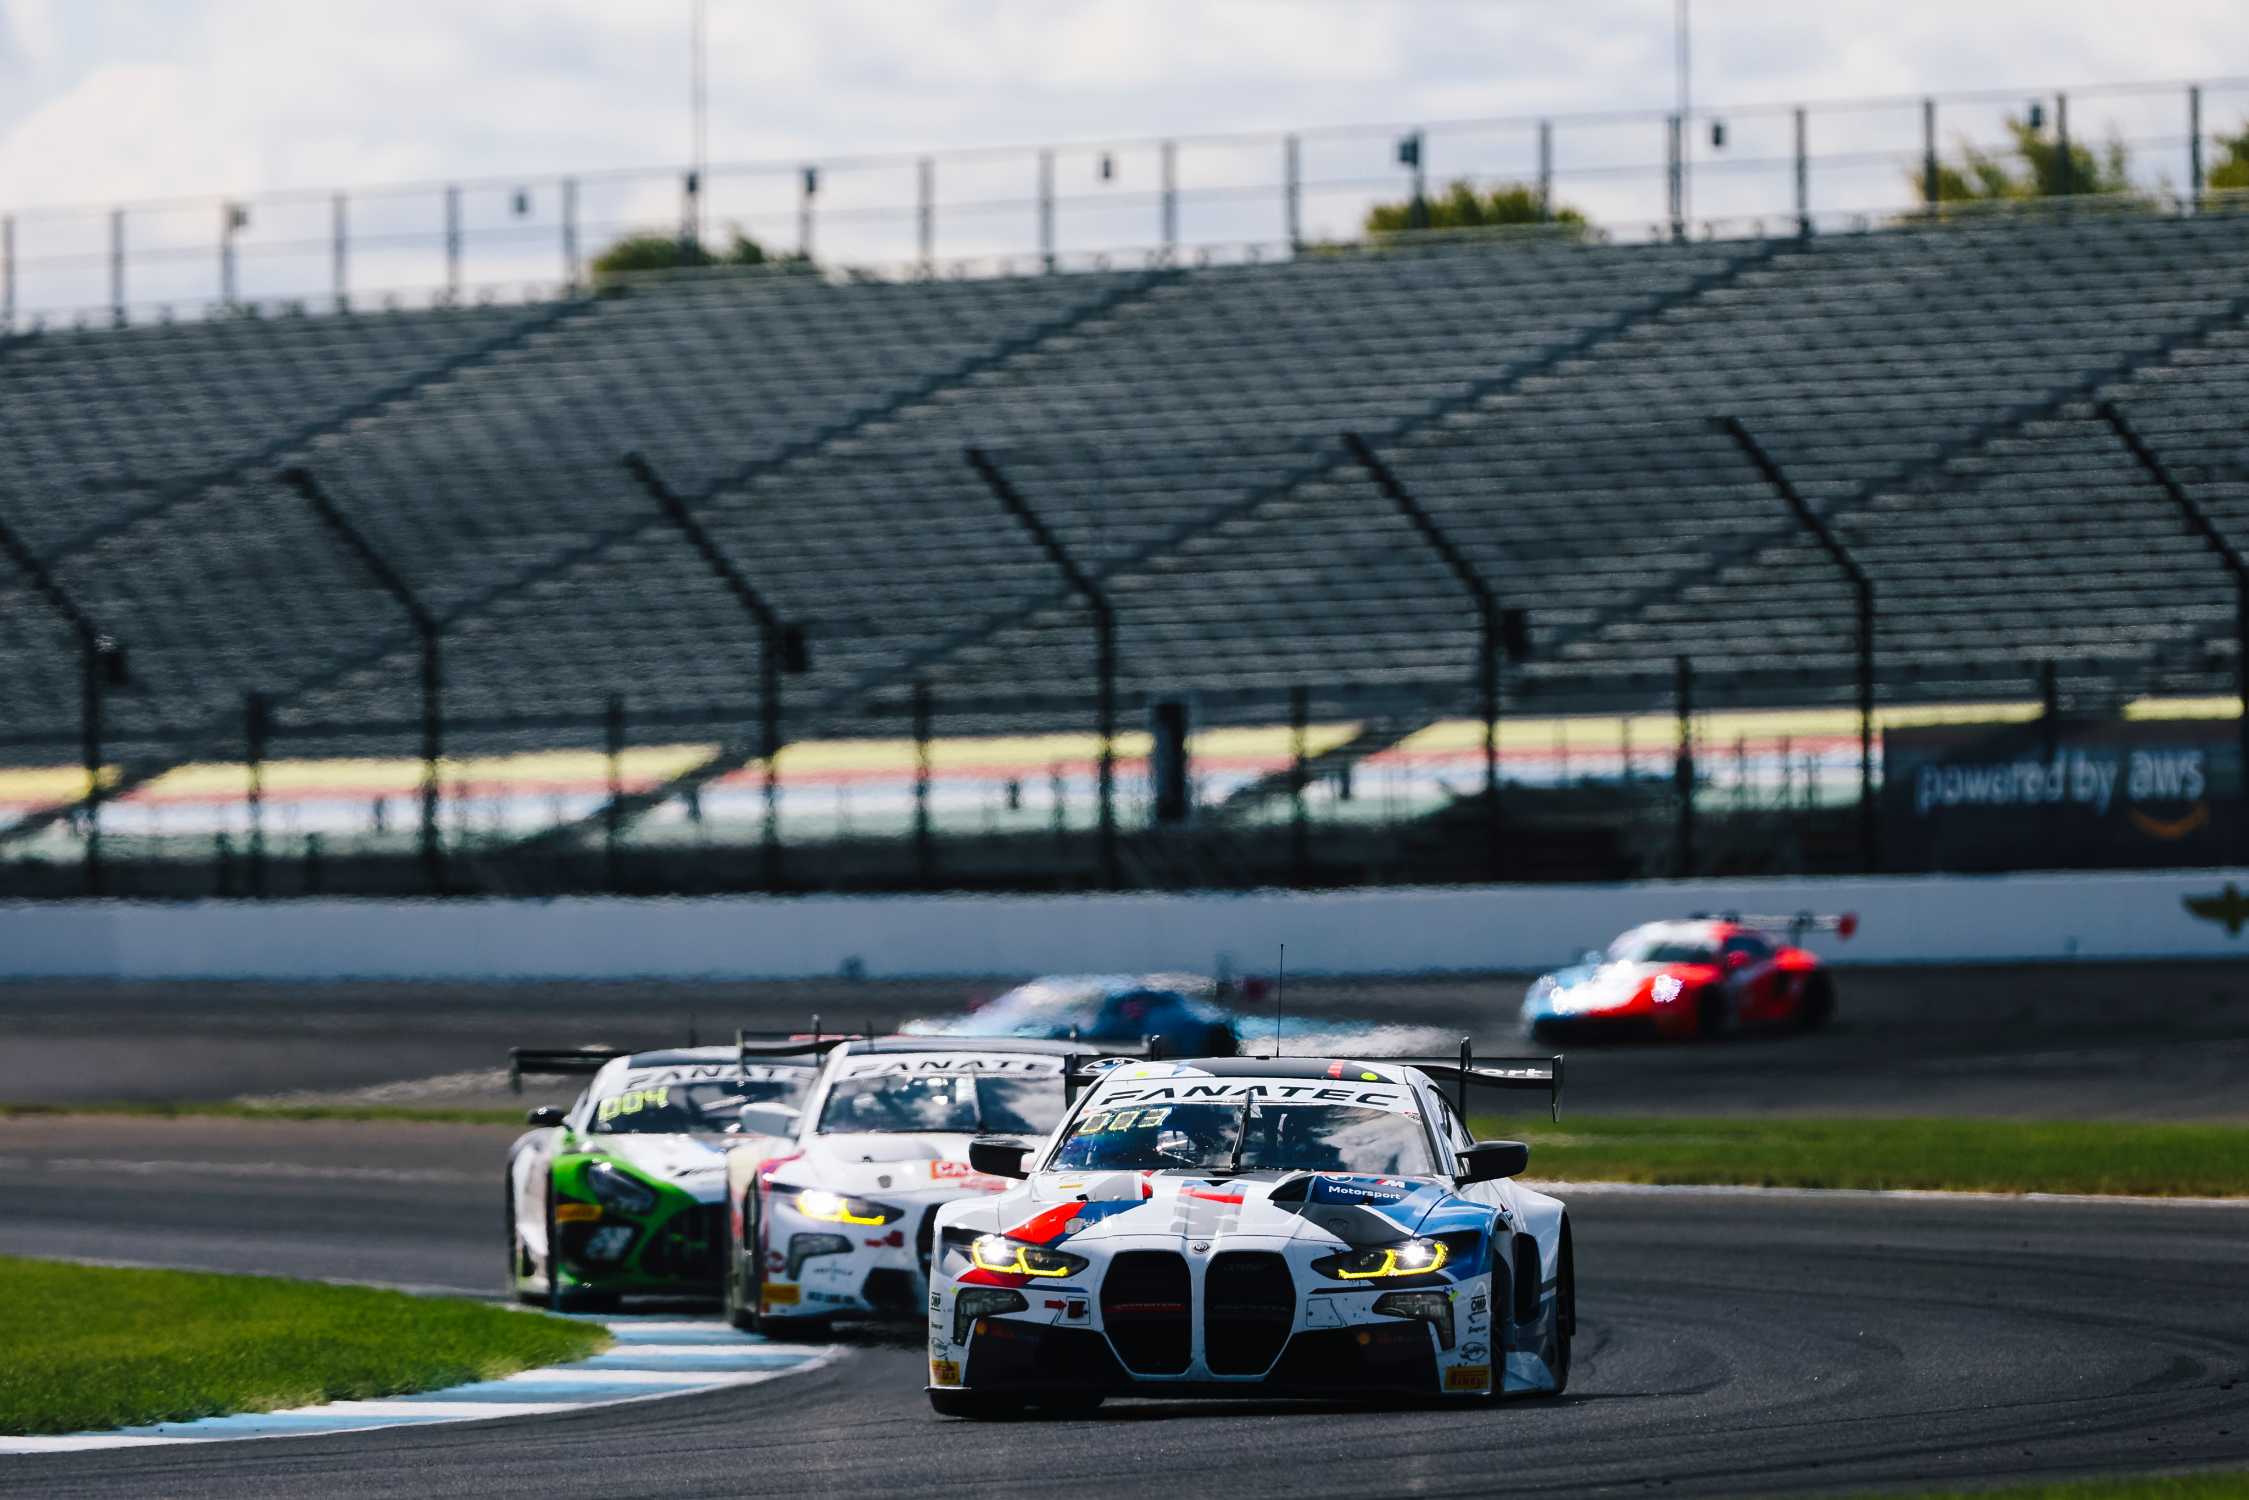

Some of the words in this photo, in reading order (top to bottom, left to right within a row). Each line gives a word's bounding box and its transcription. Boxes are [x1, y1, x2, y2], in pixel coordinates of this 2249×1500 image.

[1918, 750, 2066, 811] powered
[2070, 750, 2116, 814] by
[2129, 751, 2204, 799] aws
[848, 1060, 1064, 1077] FANATE
[598, 1086, 669, 1122] 004
[1100, 1085, 1399, 1106] FANATEC
[1080, 1107, 1173, 1133] 003
[1328, 1186, 1401, 1199] Motorsport
